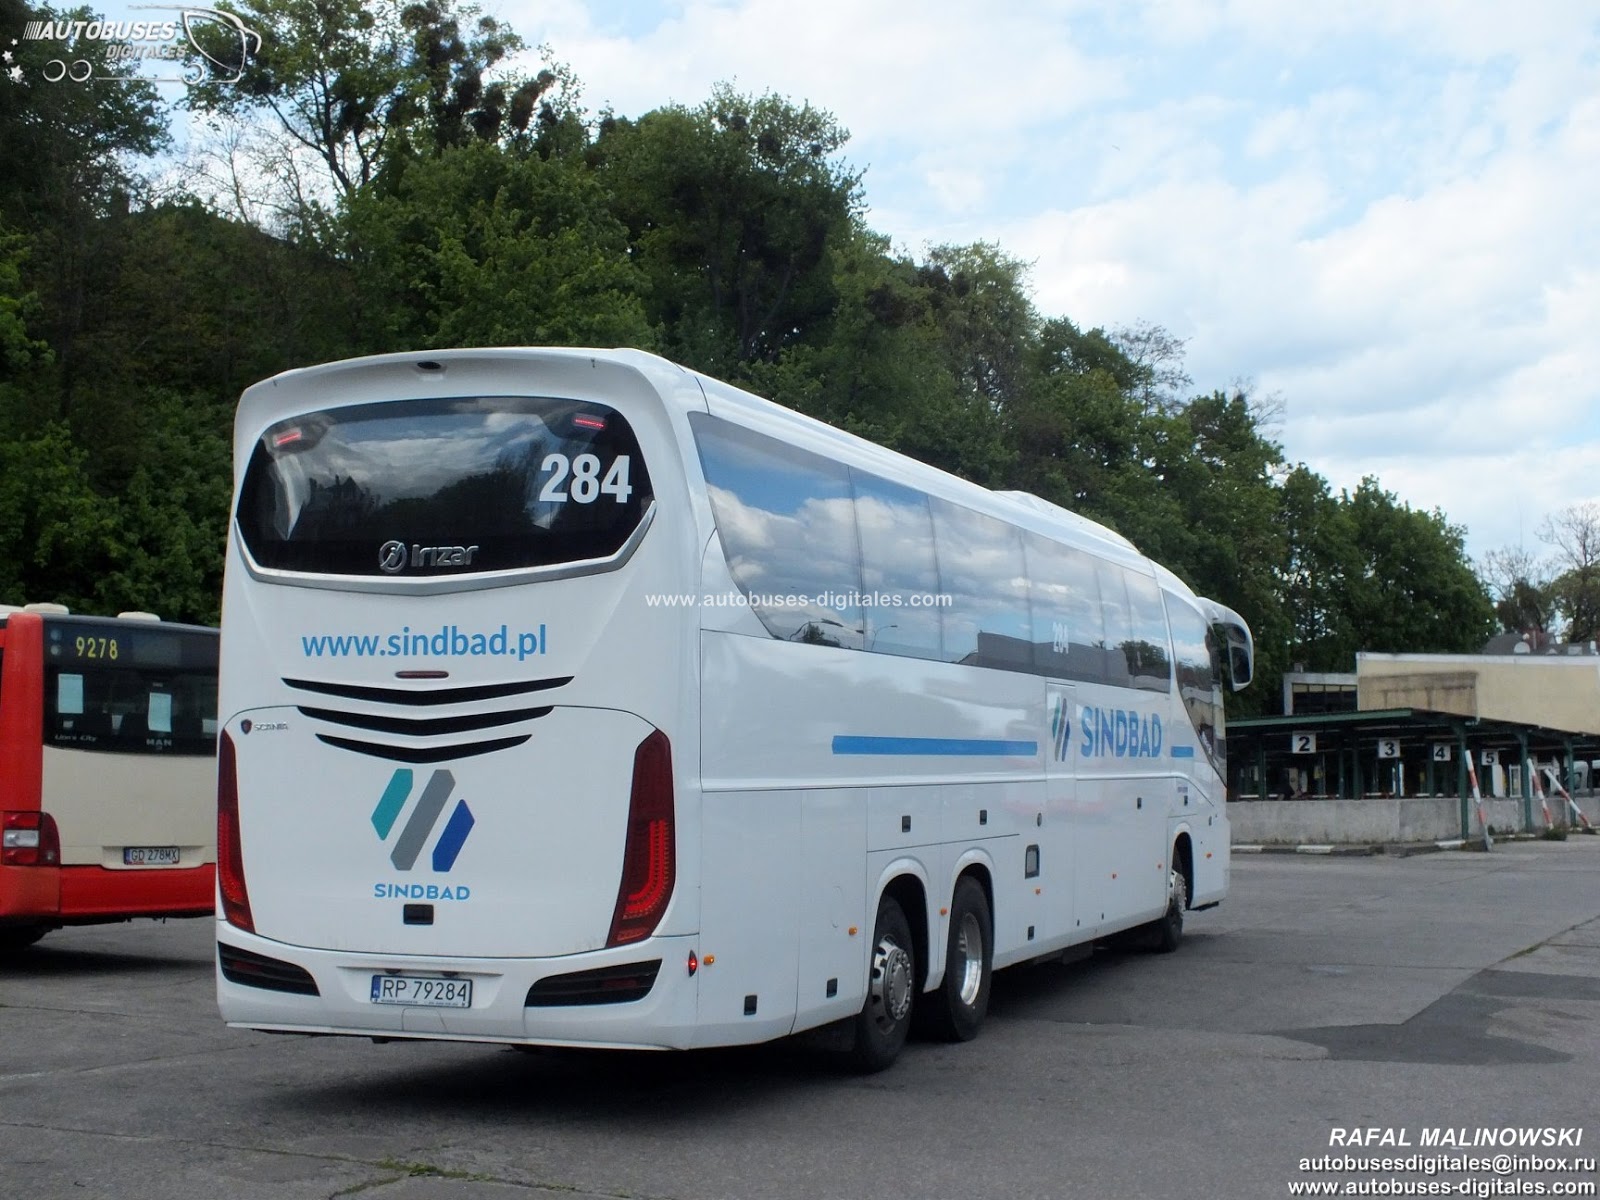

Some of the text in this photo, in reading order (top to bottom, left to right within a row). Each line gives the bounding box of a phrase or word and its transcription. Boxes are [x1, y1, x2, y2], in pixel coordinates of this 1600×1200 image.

[539, 454, 633, 503] 284
[76, 636, 118, 659] 9278
[302, 624, 547, 661] www.sindbad.pl
[1080, 706, 1162, 758] SINDBAD
[146, 738, 172, 747] MAN
[1298, 736, 1311, 752] 2
[1384, 742, 1395, 757] 3
[1435, 746, 1446, 760] 4
[1485, 752, 1495, 764] 5
[131, 849, 177, 861] GD 278MX
[374, 883, 470, 900] SINDBAD
[382, 979, 468, 1002] RP 79284
